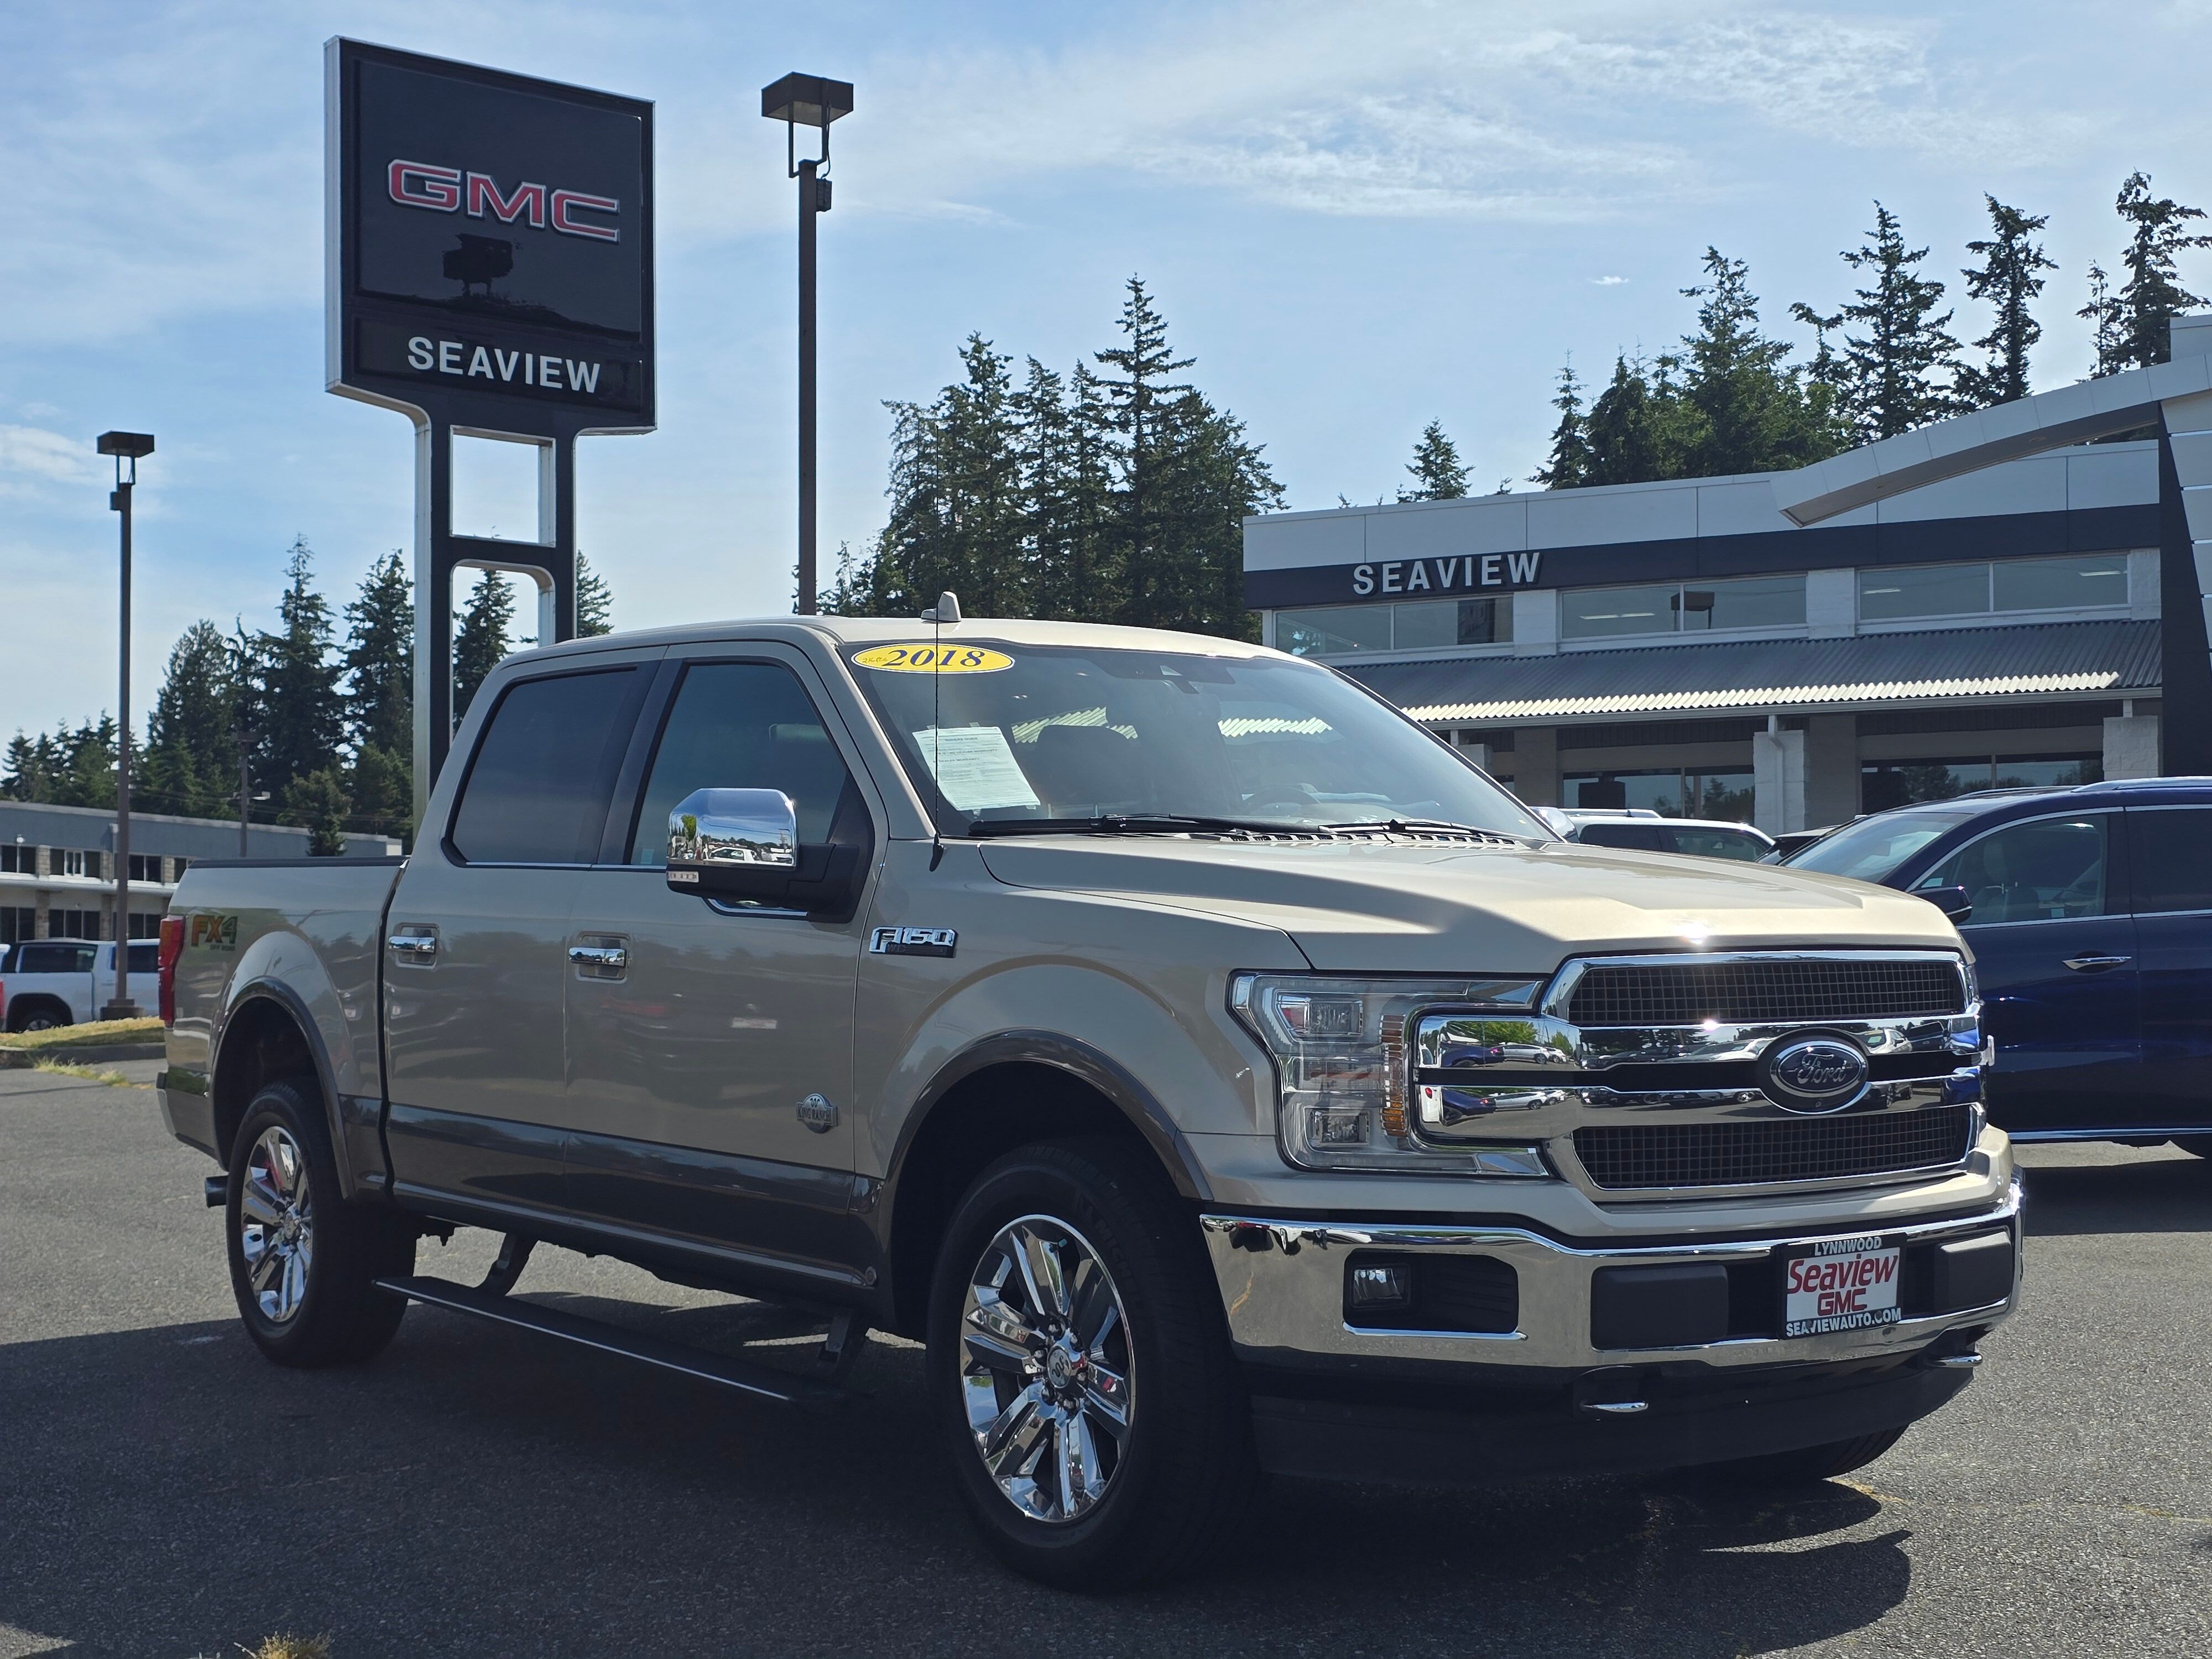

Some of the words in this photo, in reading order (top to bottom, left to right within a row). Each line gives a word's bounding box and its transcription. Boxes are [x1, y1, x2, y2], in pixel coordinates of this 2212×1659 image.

[388, 159, 620, 243] GMC
[408, 336, 601, 394] SEAVIEW
[1353, 552, 1540, 595] SEAVIEW
[881, 649, 985, 667] 2018
[191, 914, 238, 947] FX4
[1797, 1053, 1846, 1084] Ford
[1814, 1237, 1881, 1255] LYNNWOOD
[1787, 1253, 1898, 1294] Seaview
[1817, 1288, 1867, 1316] GMC
[1786, 1307, 1902, 1337] SEAVIEWAUTO.COM
